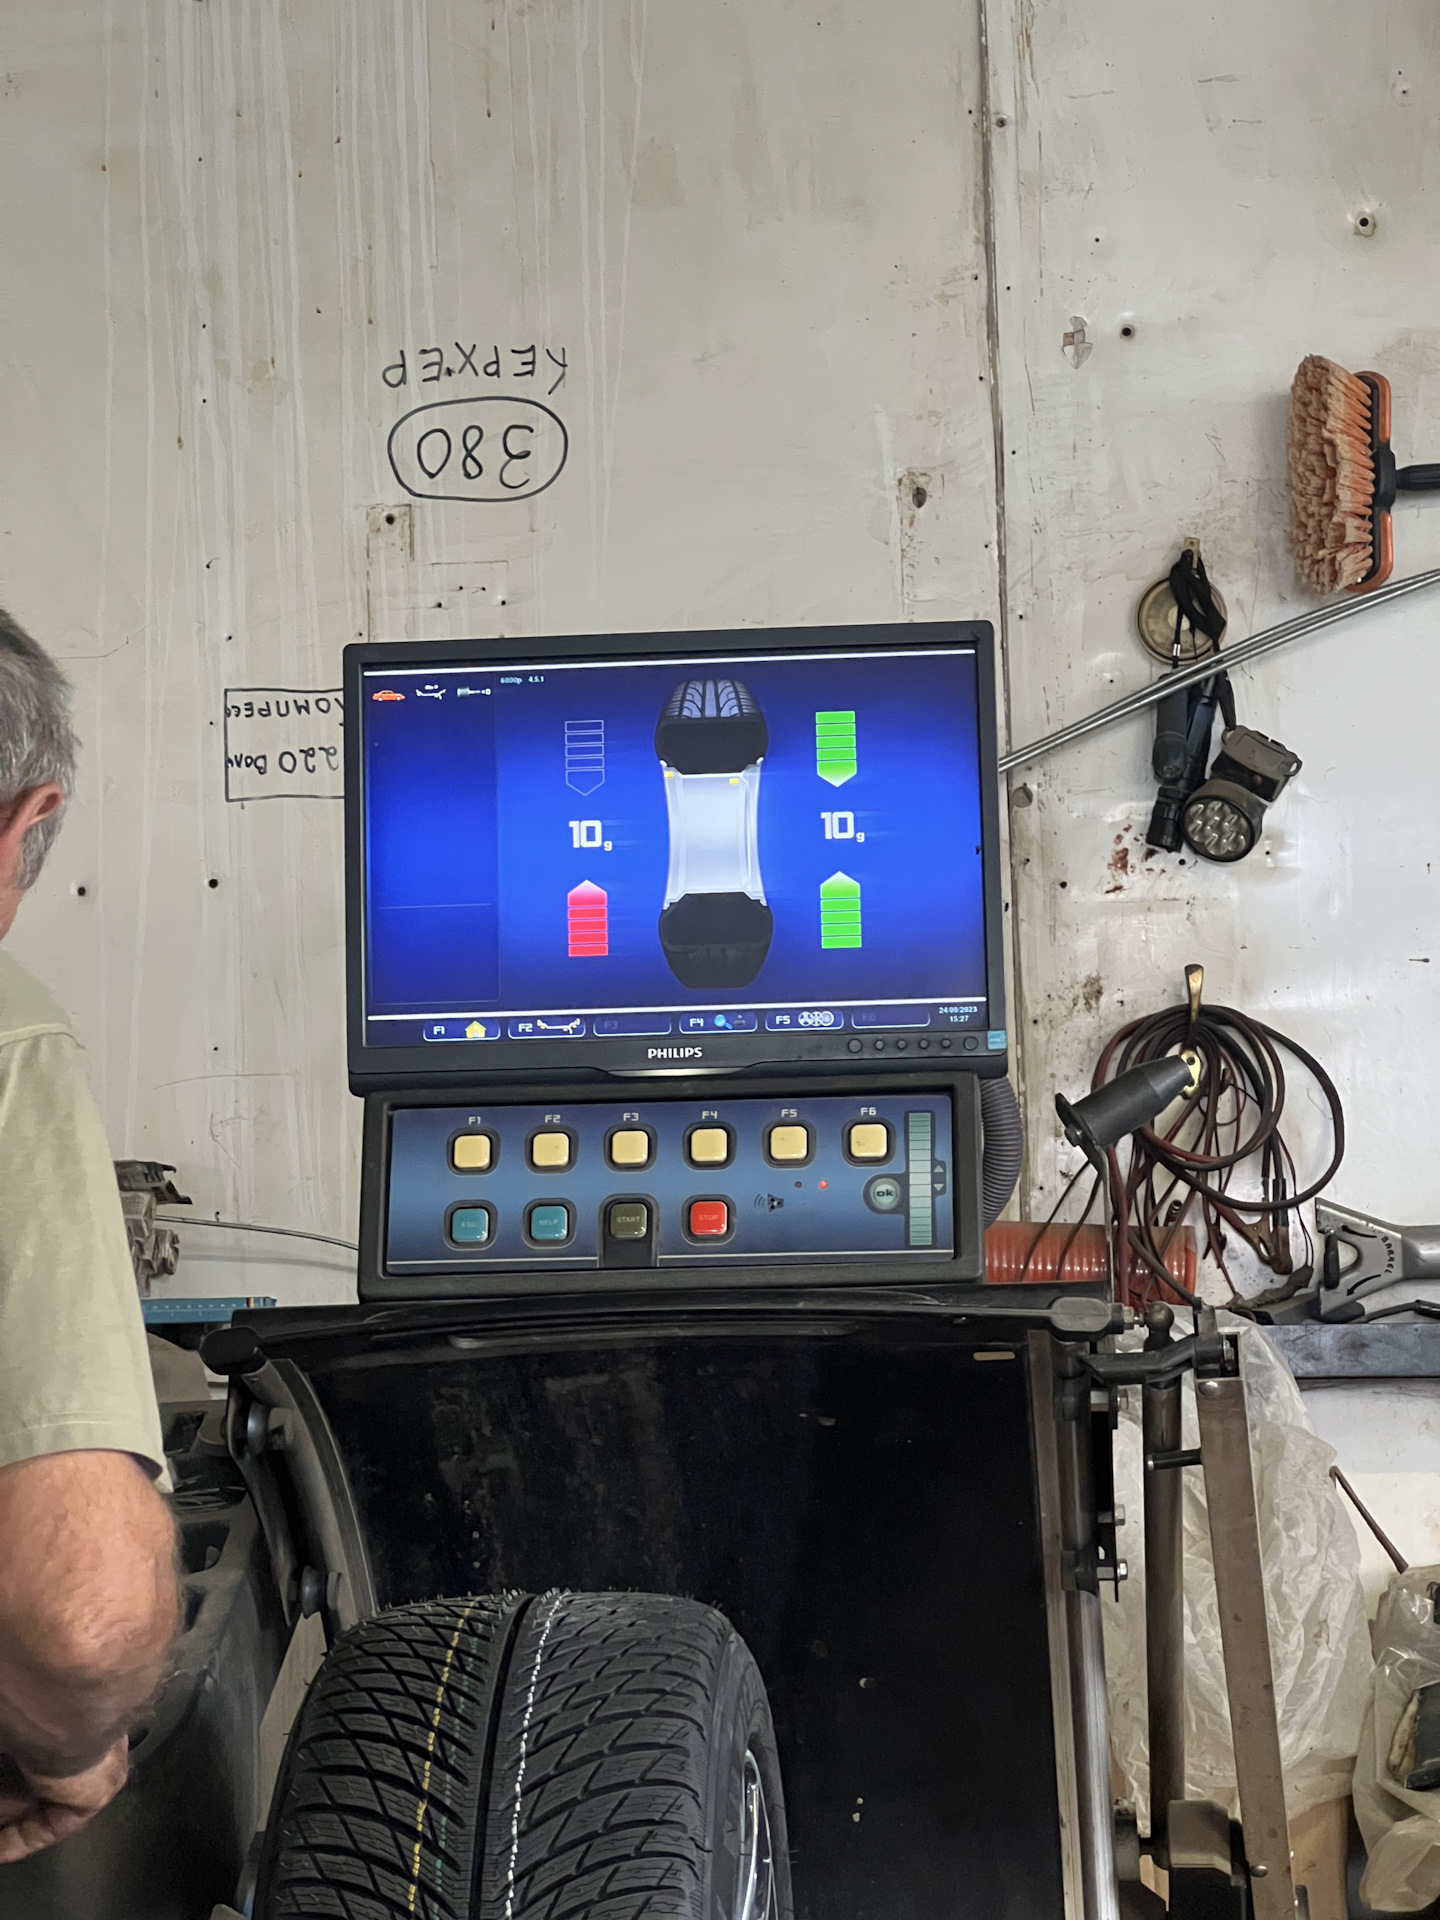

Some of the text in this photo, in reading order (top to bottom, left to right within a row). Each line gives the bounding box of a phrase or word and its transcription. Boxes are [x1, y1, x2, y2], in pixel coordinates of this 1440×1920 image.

[417, 424, 534, 489] 380
[278, 746, 339, 774] 220
[518, 1022, 533, 1033] F2
[689, 1018, 704, 1028] F4
[433, 1025, 446, 1035] F1
[647, 1047, 703, 1059] PHILIPS
[702, 1110, 718, 1119] F4
[781, 1108, 798, 1117] F5
[860, 1107, 877, 1116] F6
[468, 1116, 481, 1125] F1
[545, 1114, 561, 1123] F2
[623, 1112, 639, 1121] F3
[538, 1218, 559, 1226] HELP
[616, 1215, 641, 1224] START
[698, 1213, 719, 1222] STOP
